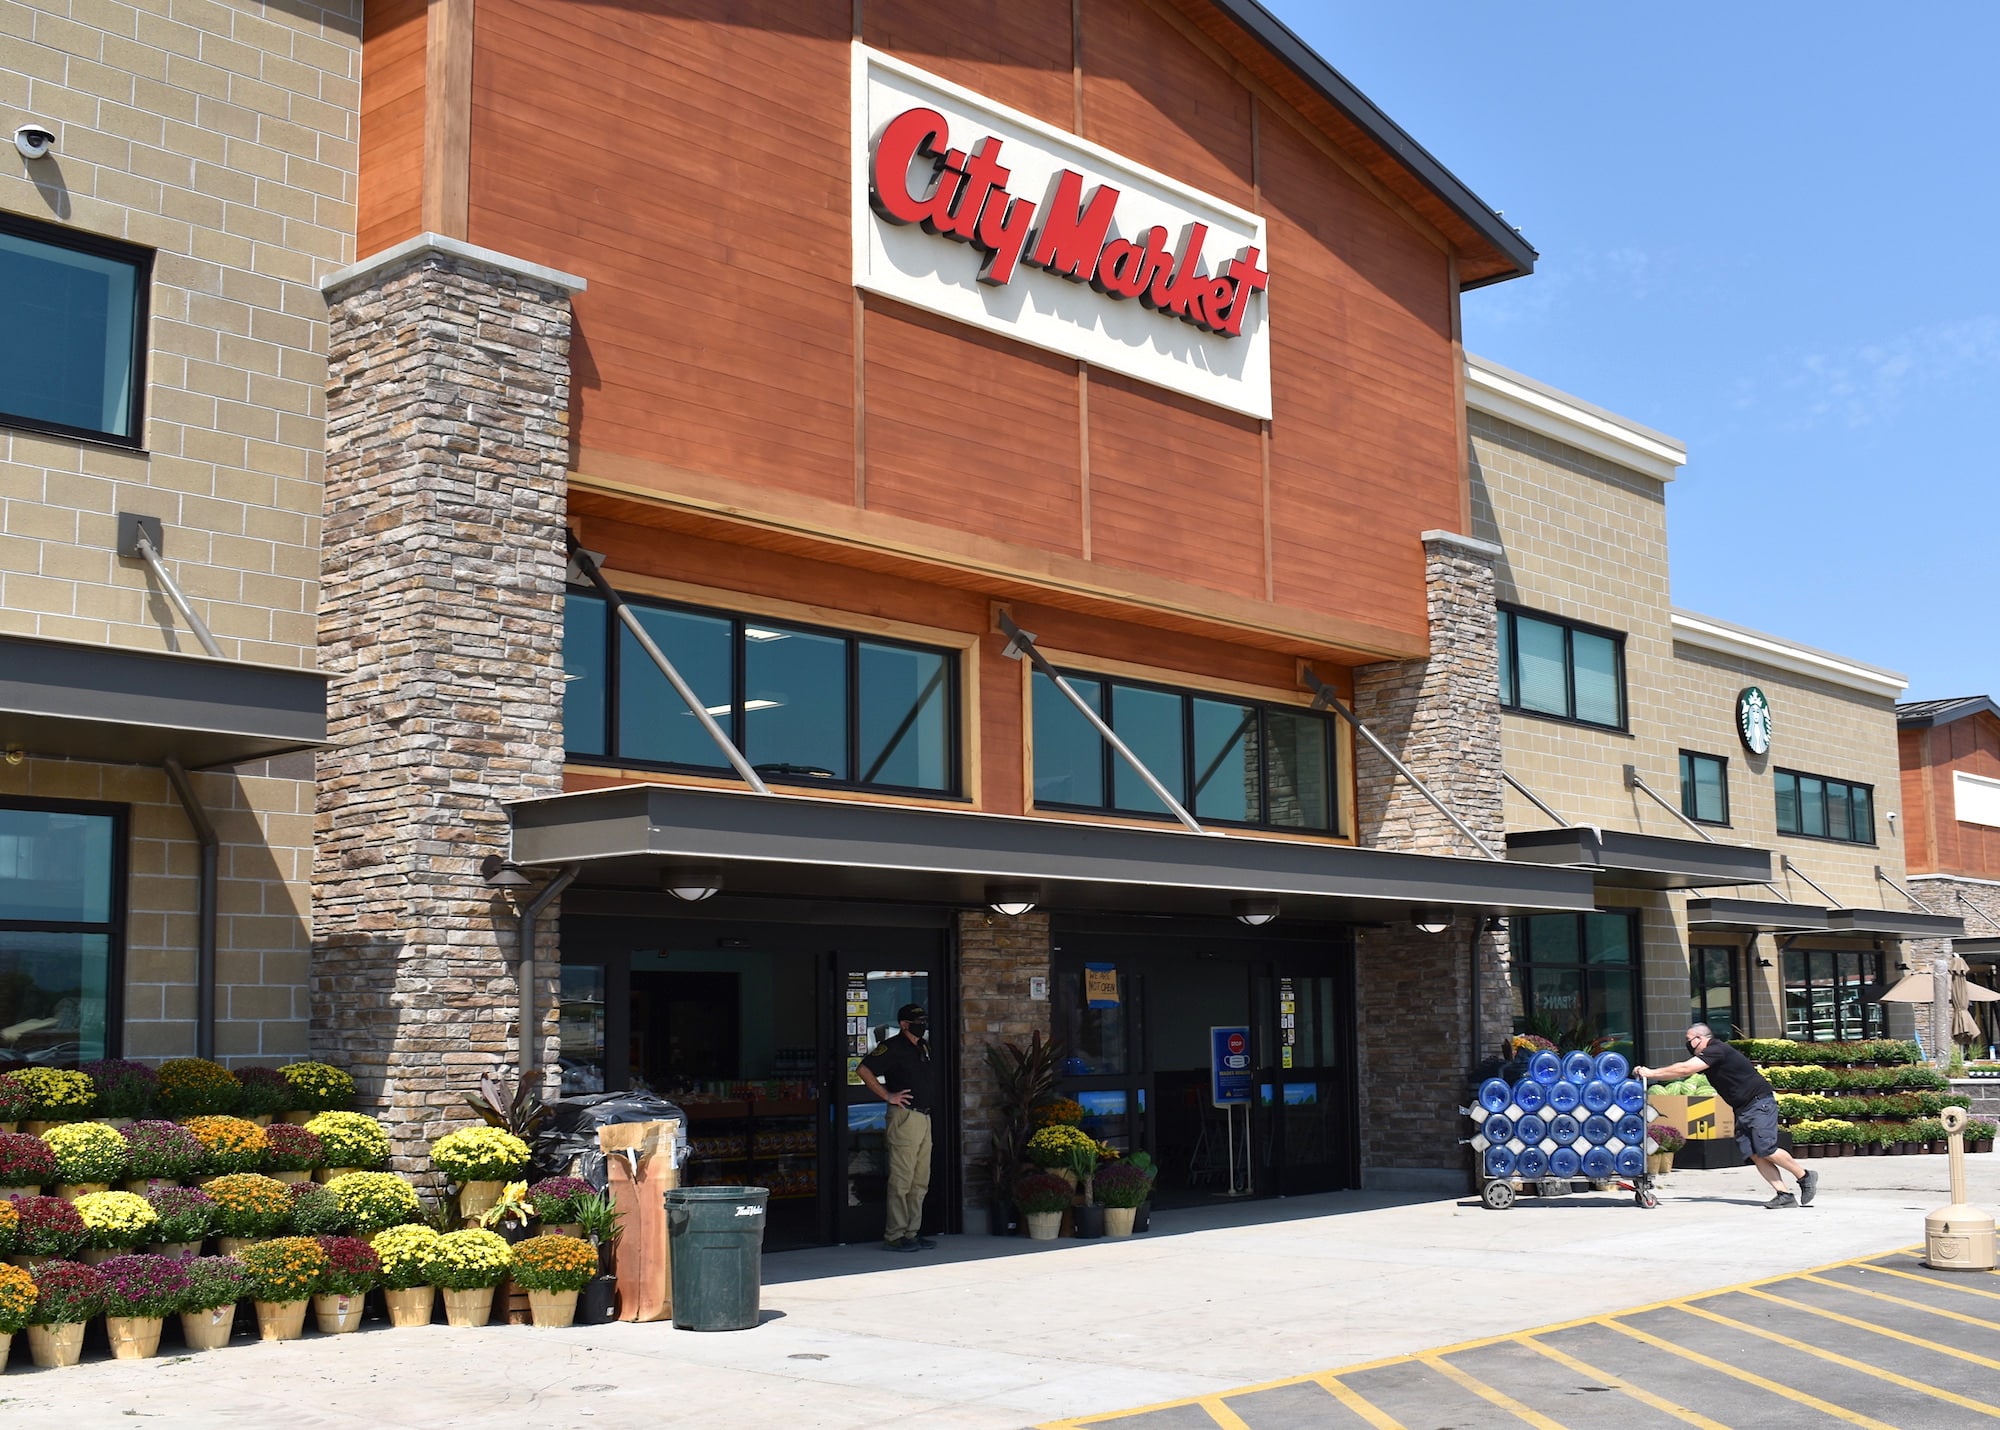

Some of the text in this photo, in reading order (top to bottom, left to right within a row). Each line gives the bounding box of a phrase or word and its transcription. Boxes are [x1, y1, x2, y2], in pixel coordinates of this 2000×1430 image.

[871, 107, 1269, 337] City Market
[1089, 980, 1116, 992] NOT OPEN
